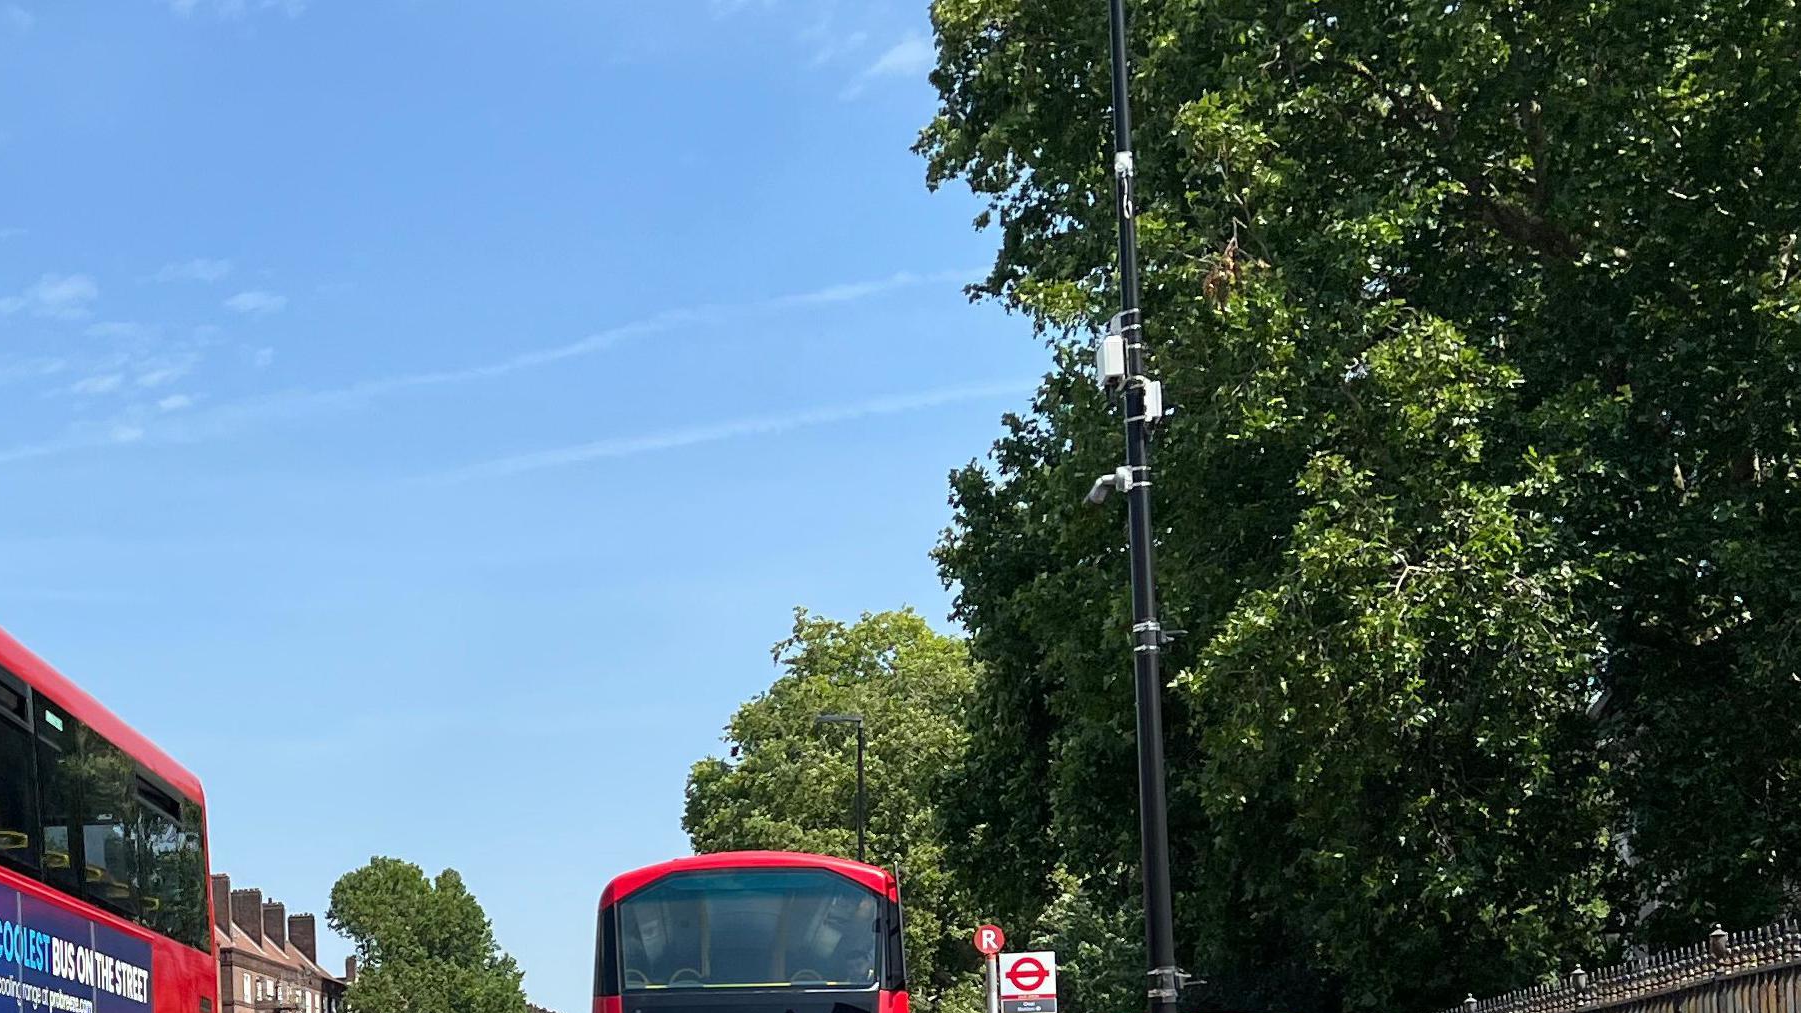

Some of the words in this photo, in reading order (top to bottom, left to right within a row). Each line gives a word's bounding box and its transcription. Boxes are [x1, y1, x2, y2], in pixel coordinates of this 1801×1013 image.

[981, 929, 999, 950] R
[52, 936, 77, 981] BUS
[76, 945, 95, 987] ON
[94, 951, 115, 994] THE
[114, 959, 149, 1004] STREET
